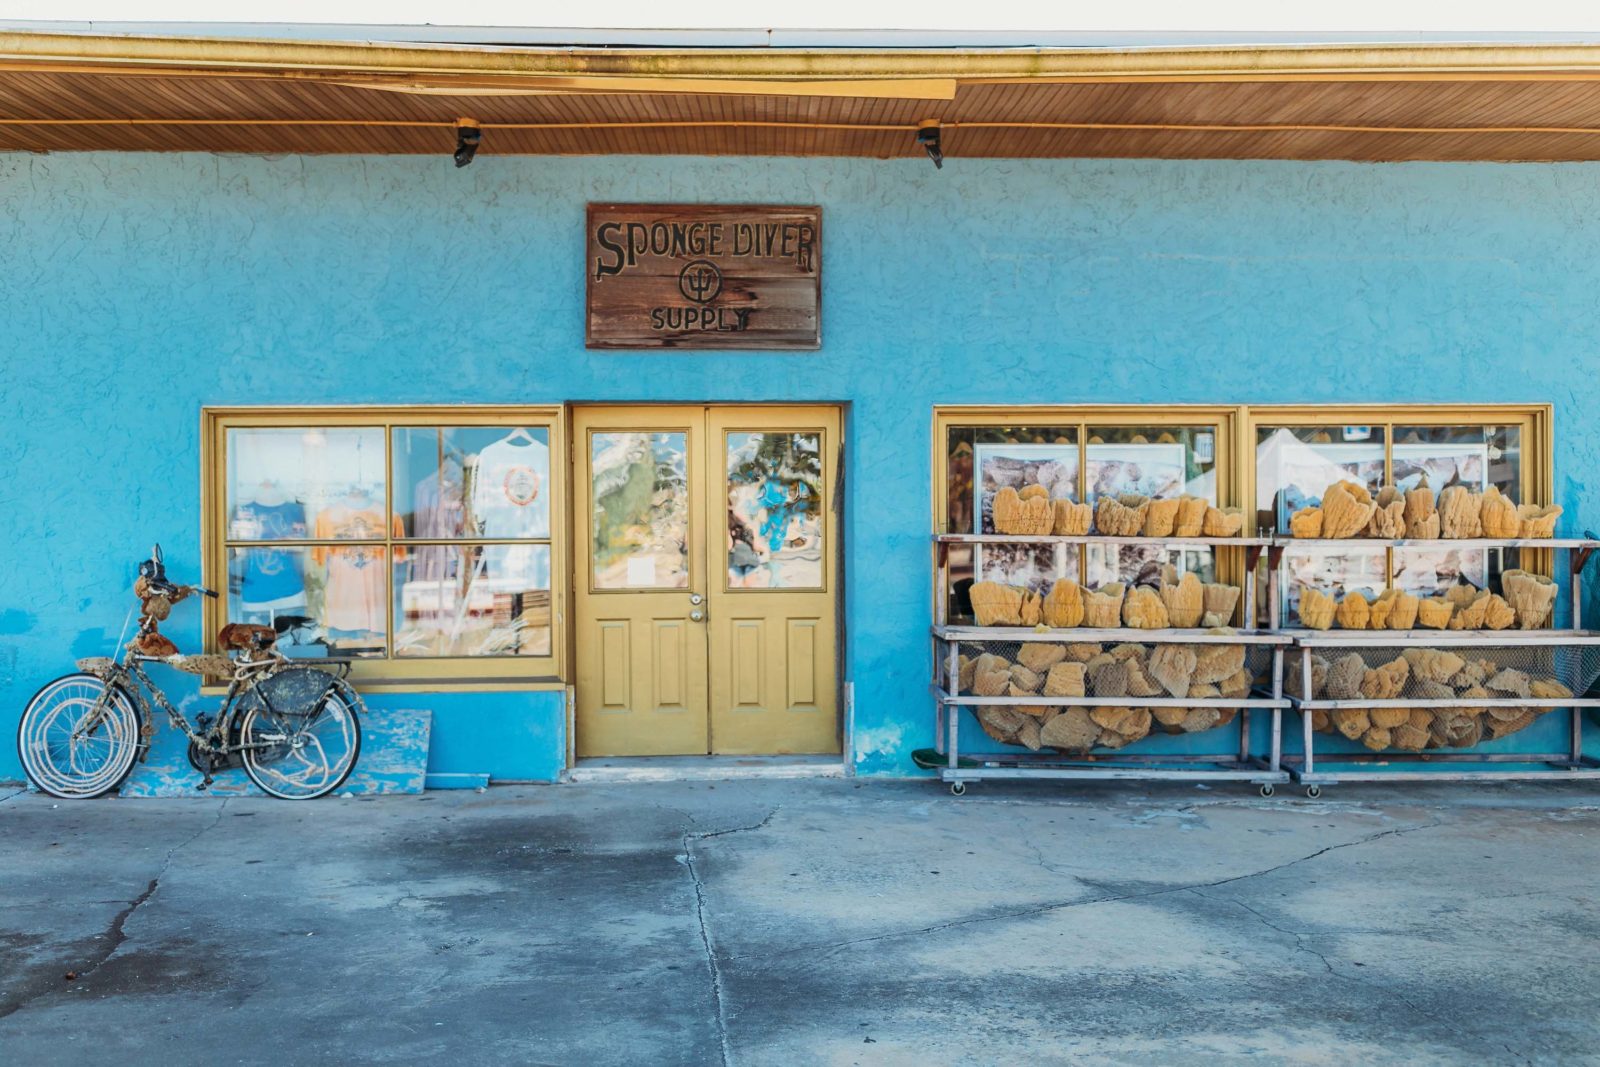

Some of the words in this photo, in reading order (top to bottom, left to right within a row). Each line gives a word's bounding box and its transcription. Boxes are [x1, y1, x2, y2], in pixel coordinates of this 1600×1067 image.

[596, 222, 723, 281] SPONGE
[733, 223, 815, 272] DIVER
[651, 308, 752, 331] SUPPLY
